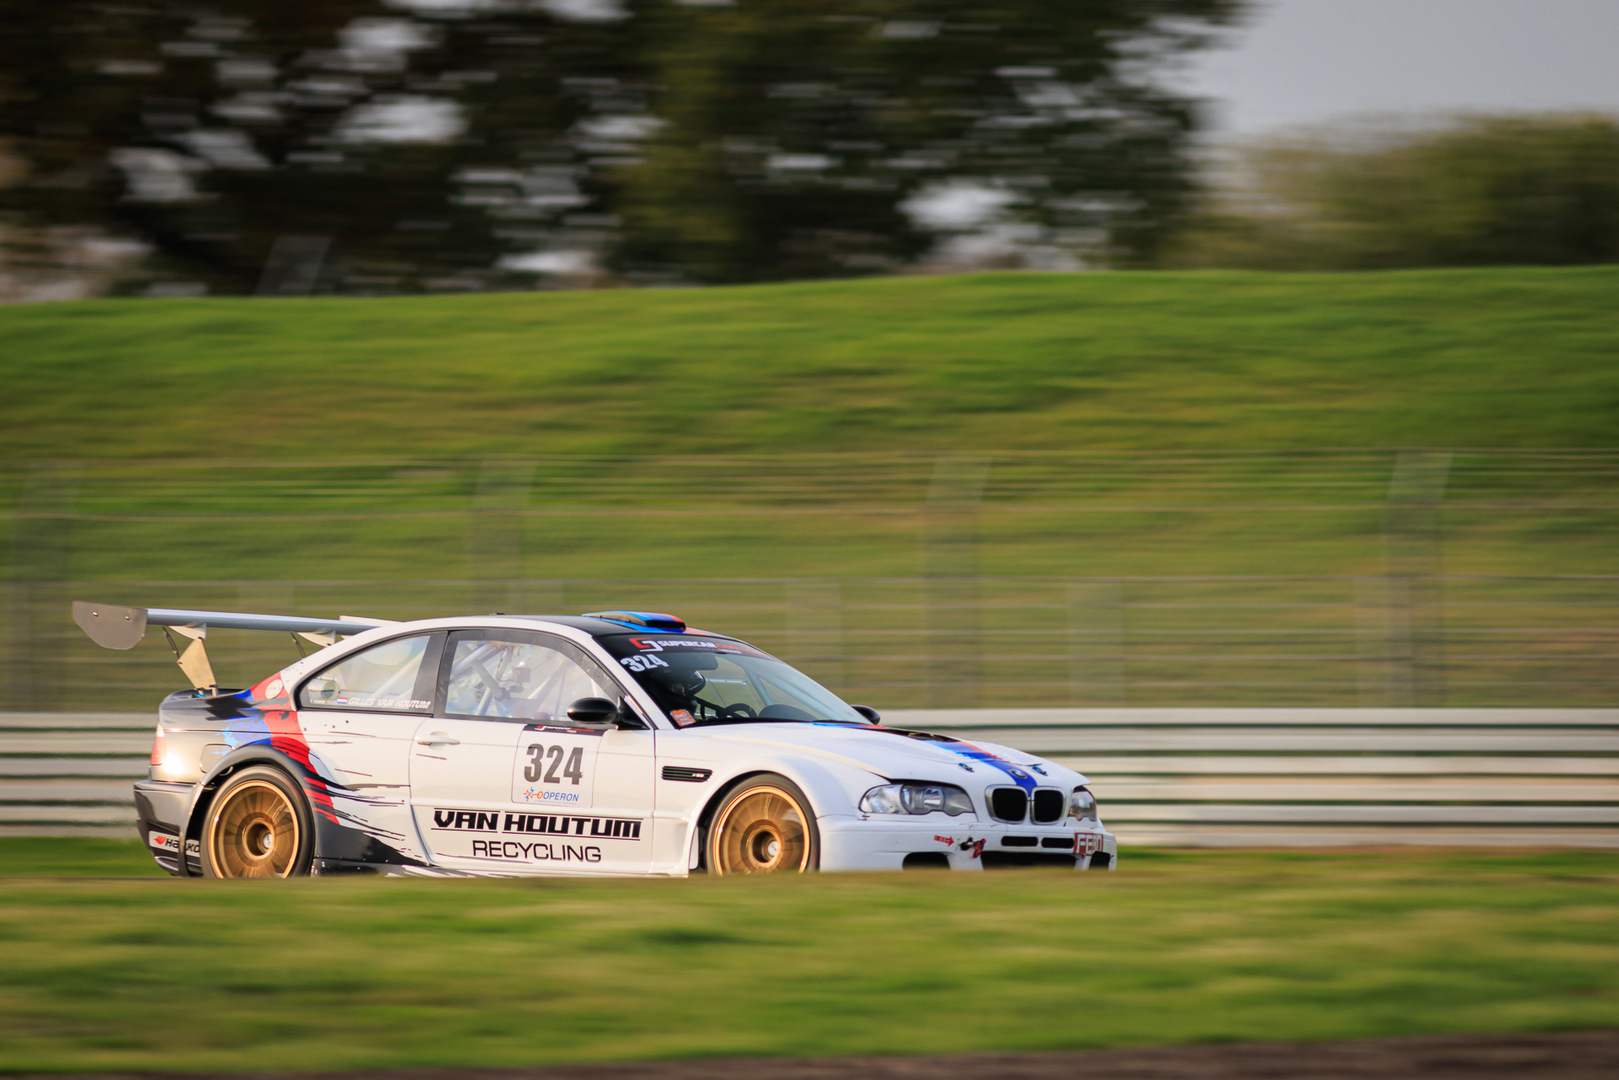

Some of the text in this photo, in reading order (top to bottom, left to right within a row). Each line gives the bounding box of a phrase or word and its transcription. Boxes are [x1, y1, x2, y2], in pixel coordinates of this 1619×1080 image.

[657, 640, 718, 648] SUPERCAR
[620, 653, 669, 672] 324
[376, 698, 395, 708] VAN
[395, 699, 431, 709] HOUTUM
[524, 743, 584, 785] 324
[434, 810, 642, 838] VAN HOUTUM
[472, 840, 602, 863] RECYCLING
